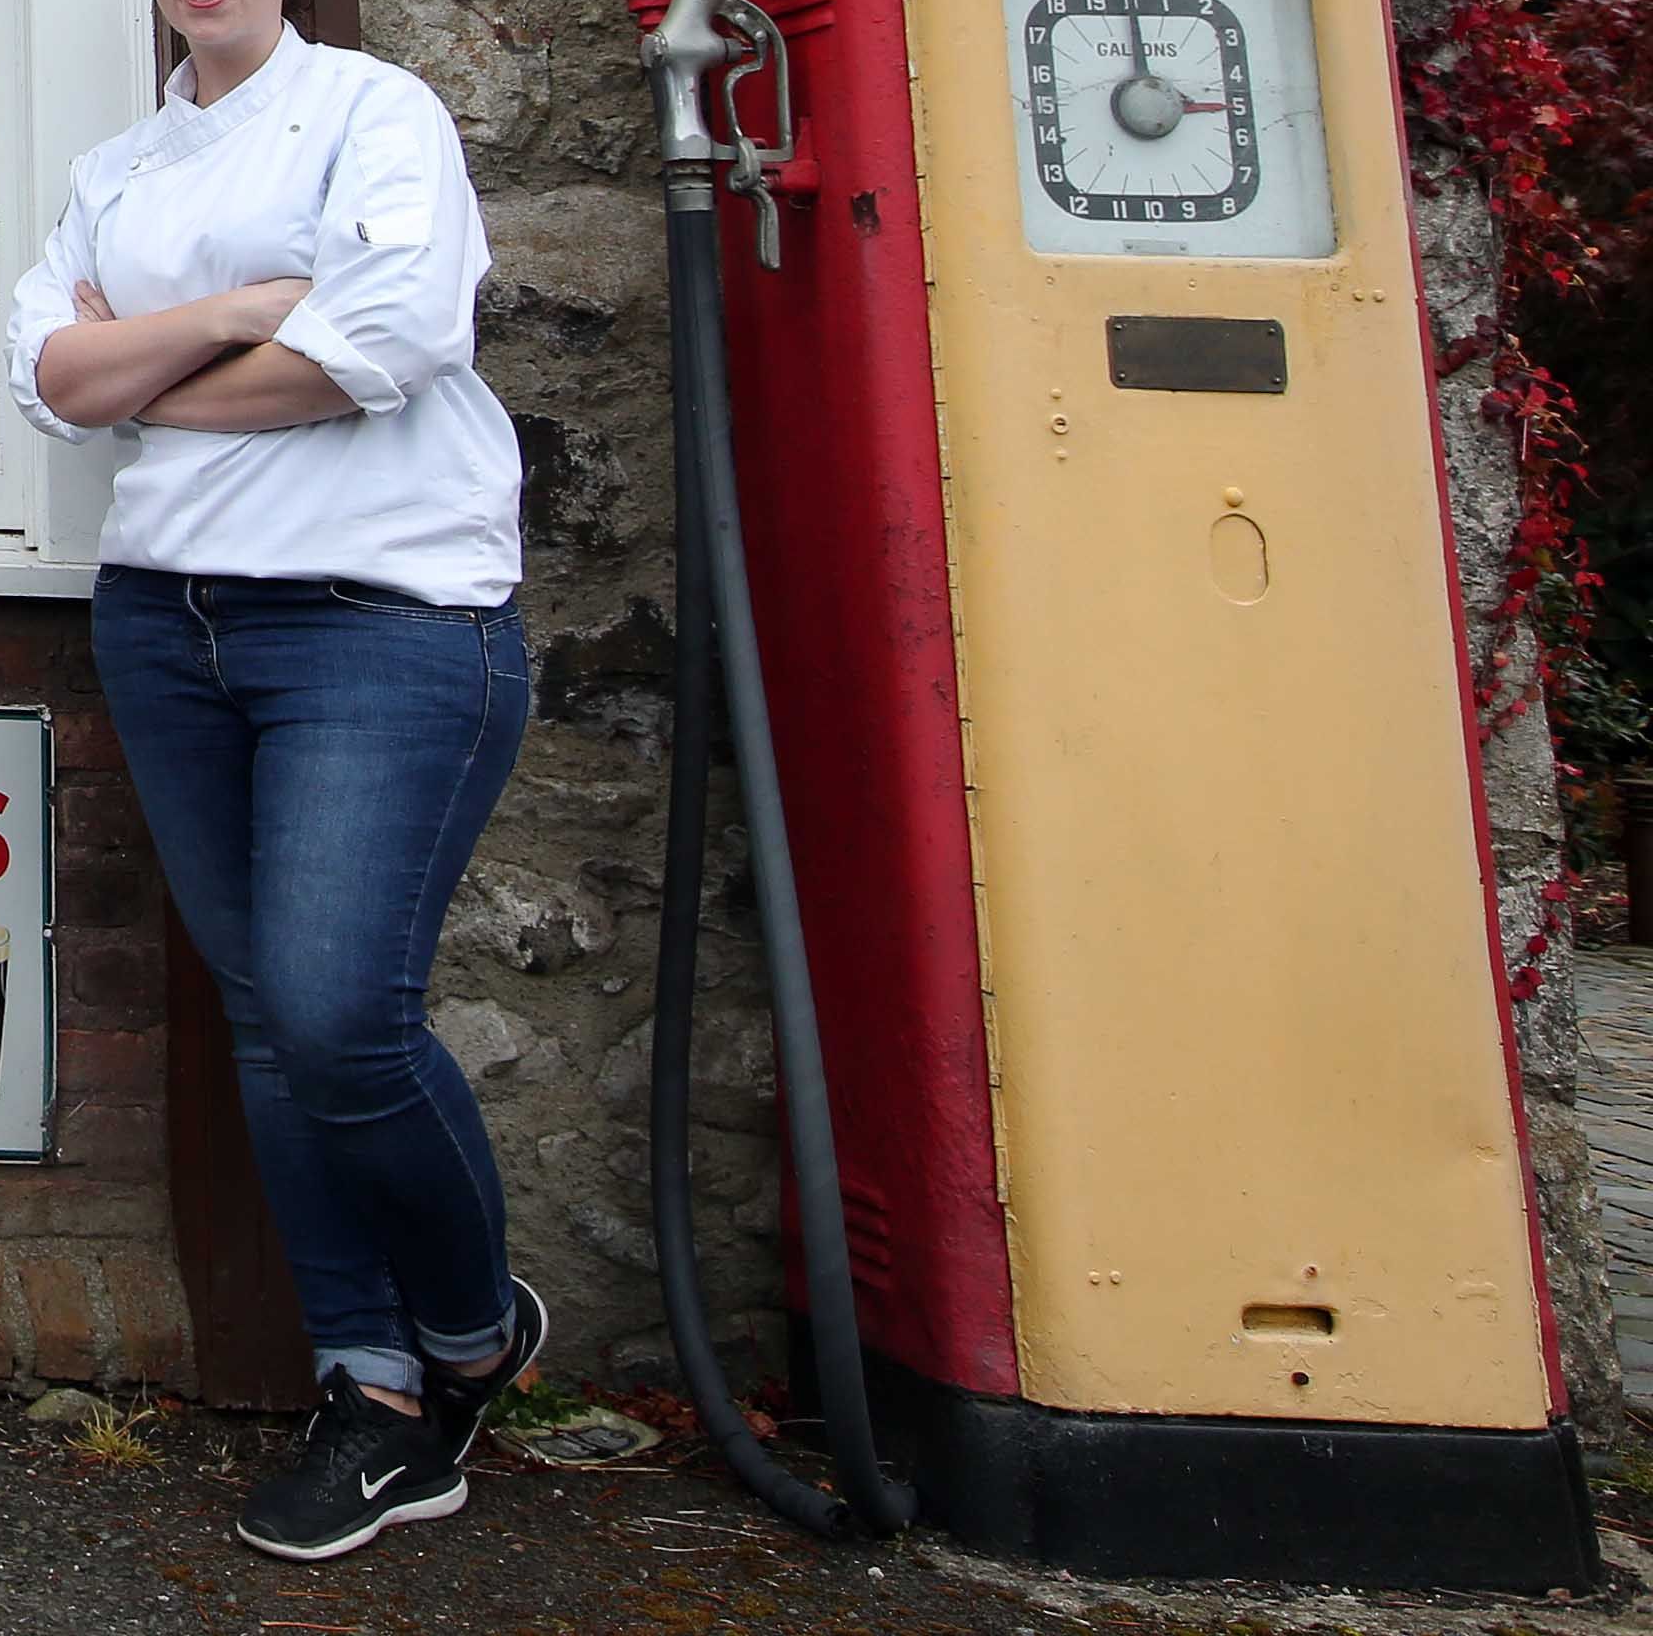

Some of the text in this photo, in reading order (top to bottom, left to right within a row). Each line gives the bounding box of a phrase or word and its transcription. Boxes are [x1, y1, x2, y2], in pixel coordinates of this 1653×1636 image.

[1029, 27, 1046, 44] 17
[1225, 29, 1238, 46] 3
[1097, 42, 1177, 57] GALONS
[1032, 65, 1051, 83] 16
[1230, 65, 1242, 83] 4
[1036, 96, 1055, 114] 15
[1232, 98, 1246, 115] 5
[1039, 126, 1058, 144] 14
[1236, 128, 1248, 145] 6
[1044, 164, 1063, 182] 13
[1239, 166, 1252, 184] 7
[1069, 196, 1089, 215] 12
[1113, 201, 1128, 218] 11
[1145, 201, 1164, 219] 10
[1182, 201, 1196, 218] 9
[1222, 197, 1236, 215] 8
